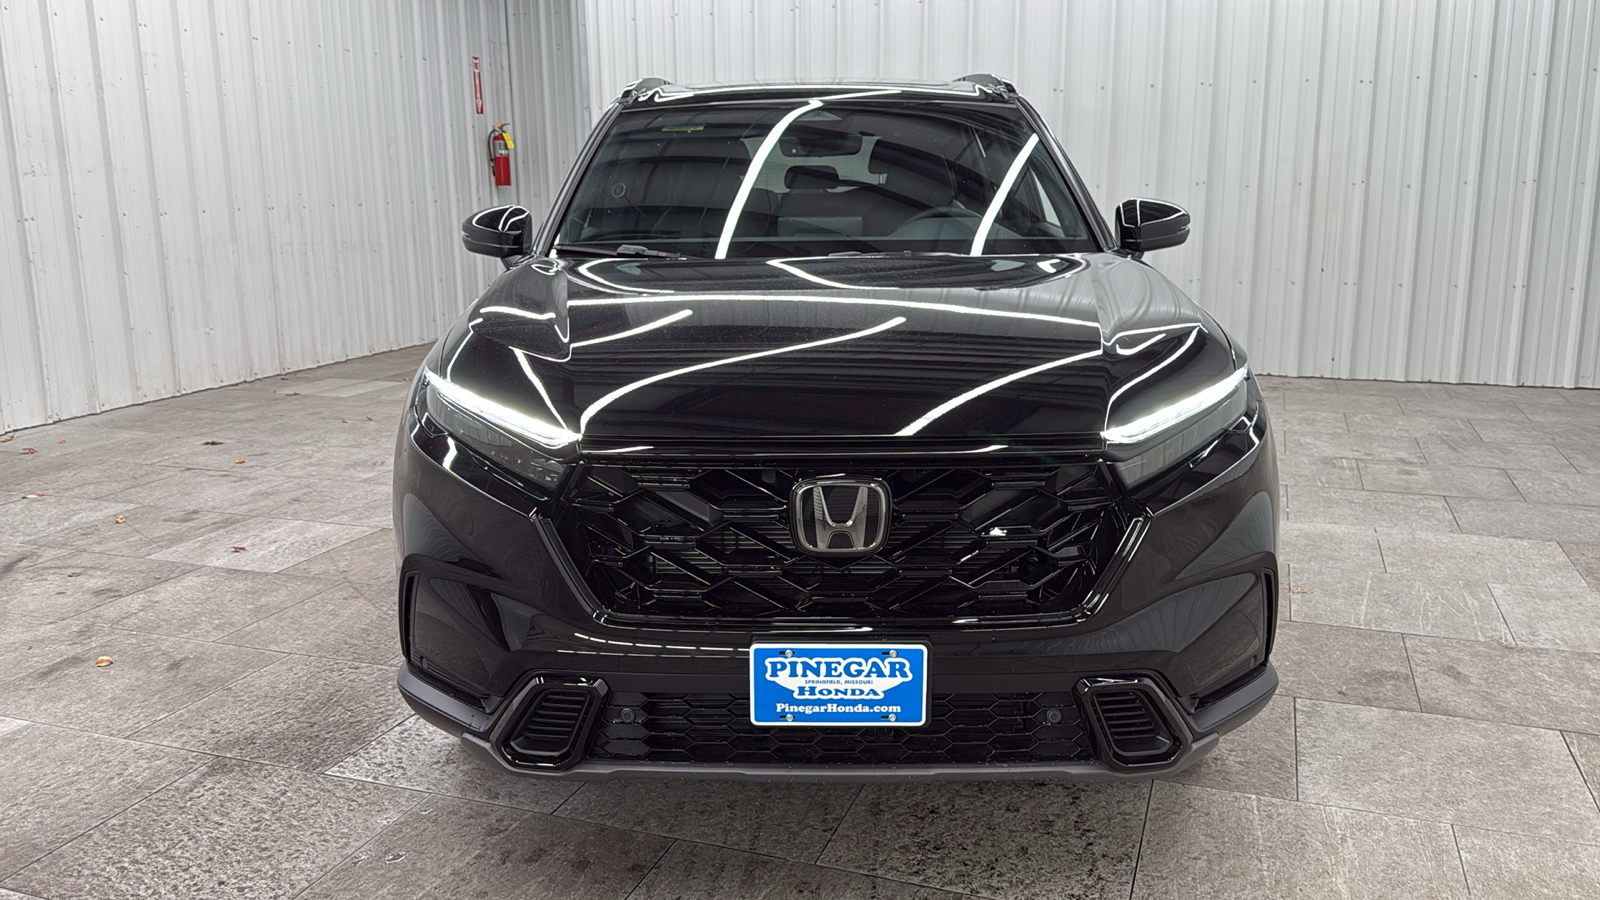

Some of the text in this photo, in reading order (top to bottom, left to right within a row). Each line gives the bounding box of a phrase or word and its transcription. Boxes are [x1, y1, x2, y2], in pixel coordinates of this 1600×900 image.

[768, 661, 909, 678] PINEGAR
[797, 686, 881, 696] HONDA
[776, 703, 901, 714] PinegarHonda.com
